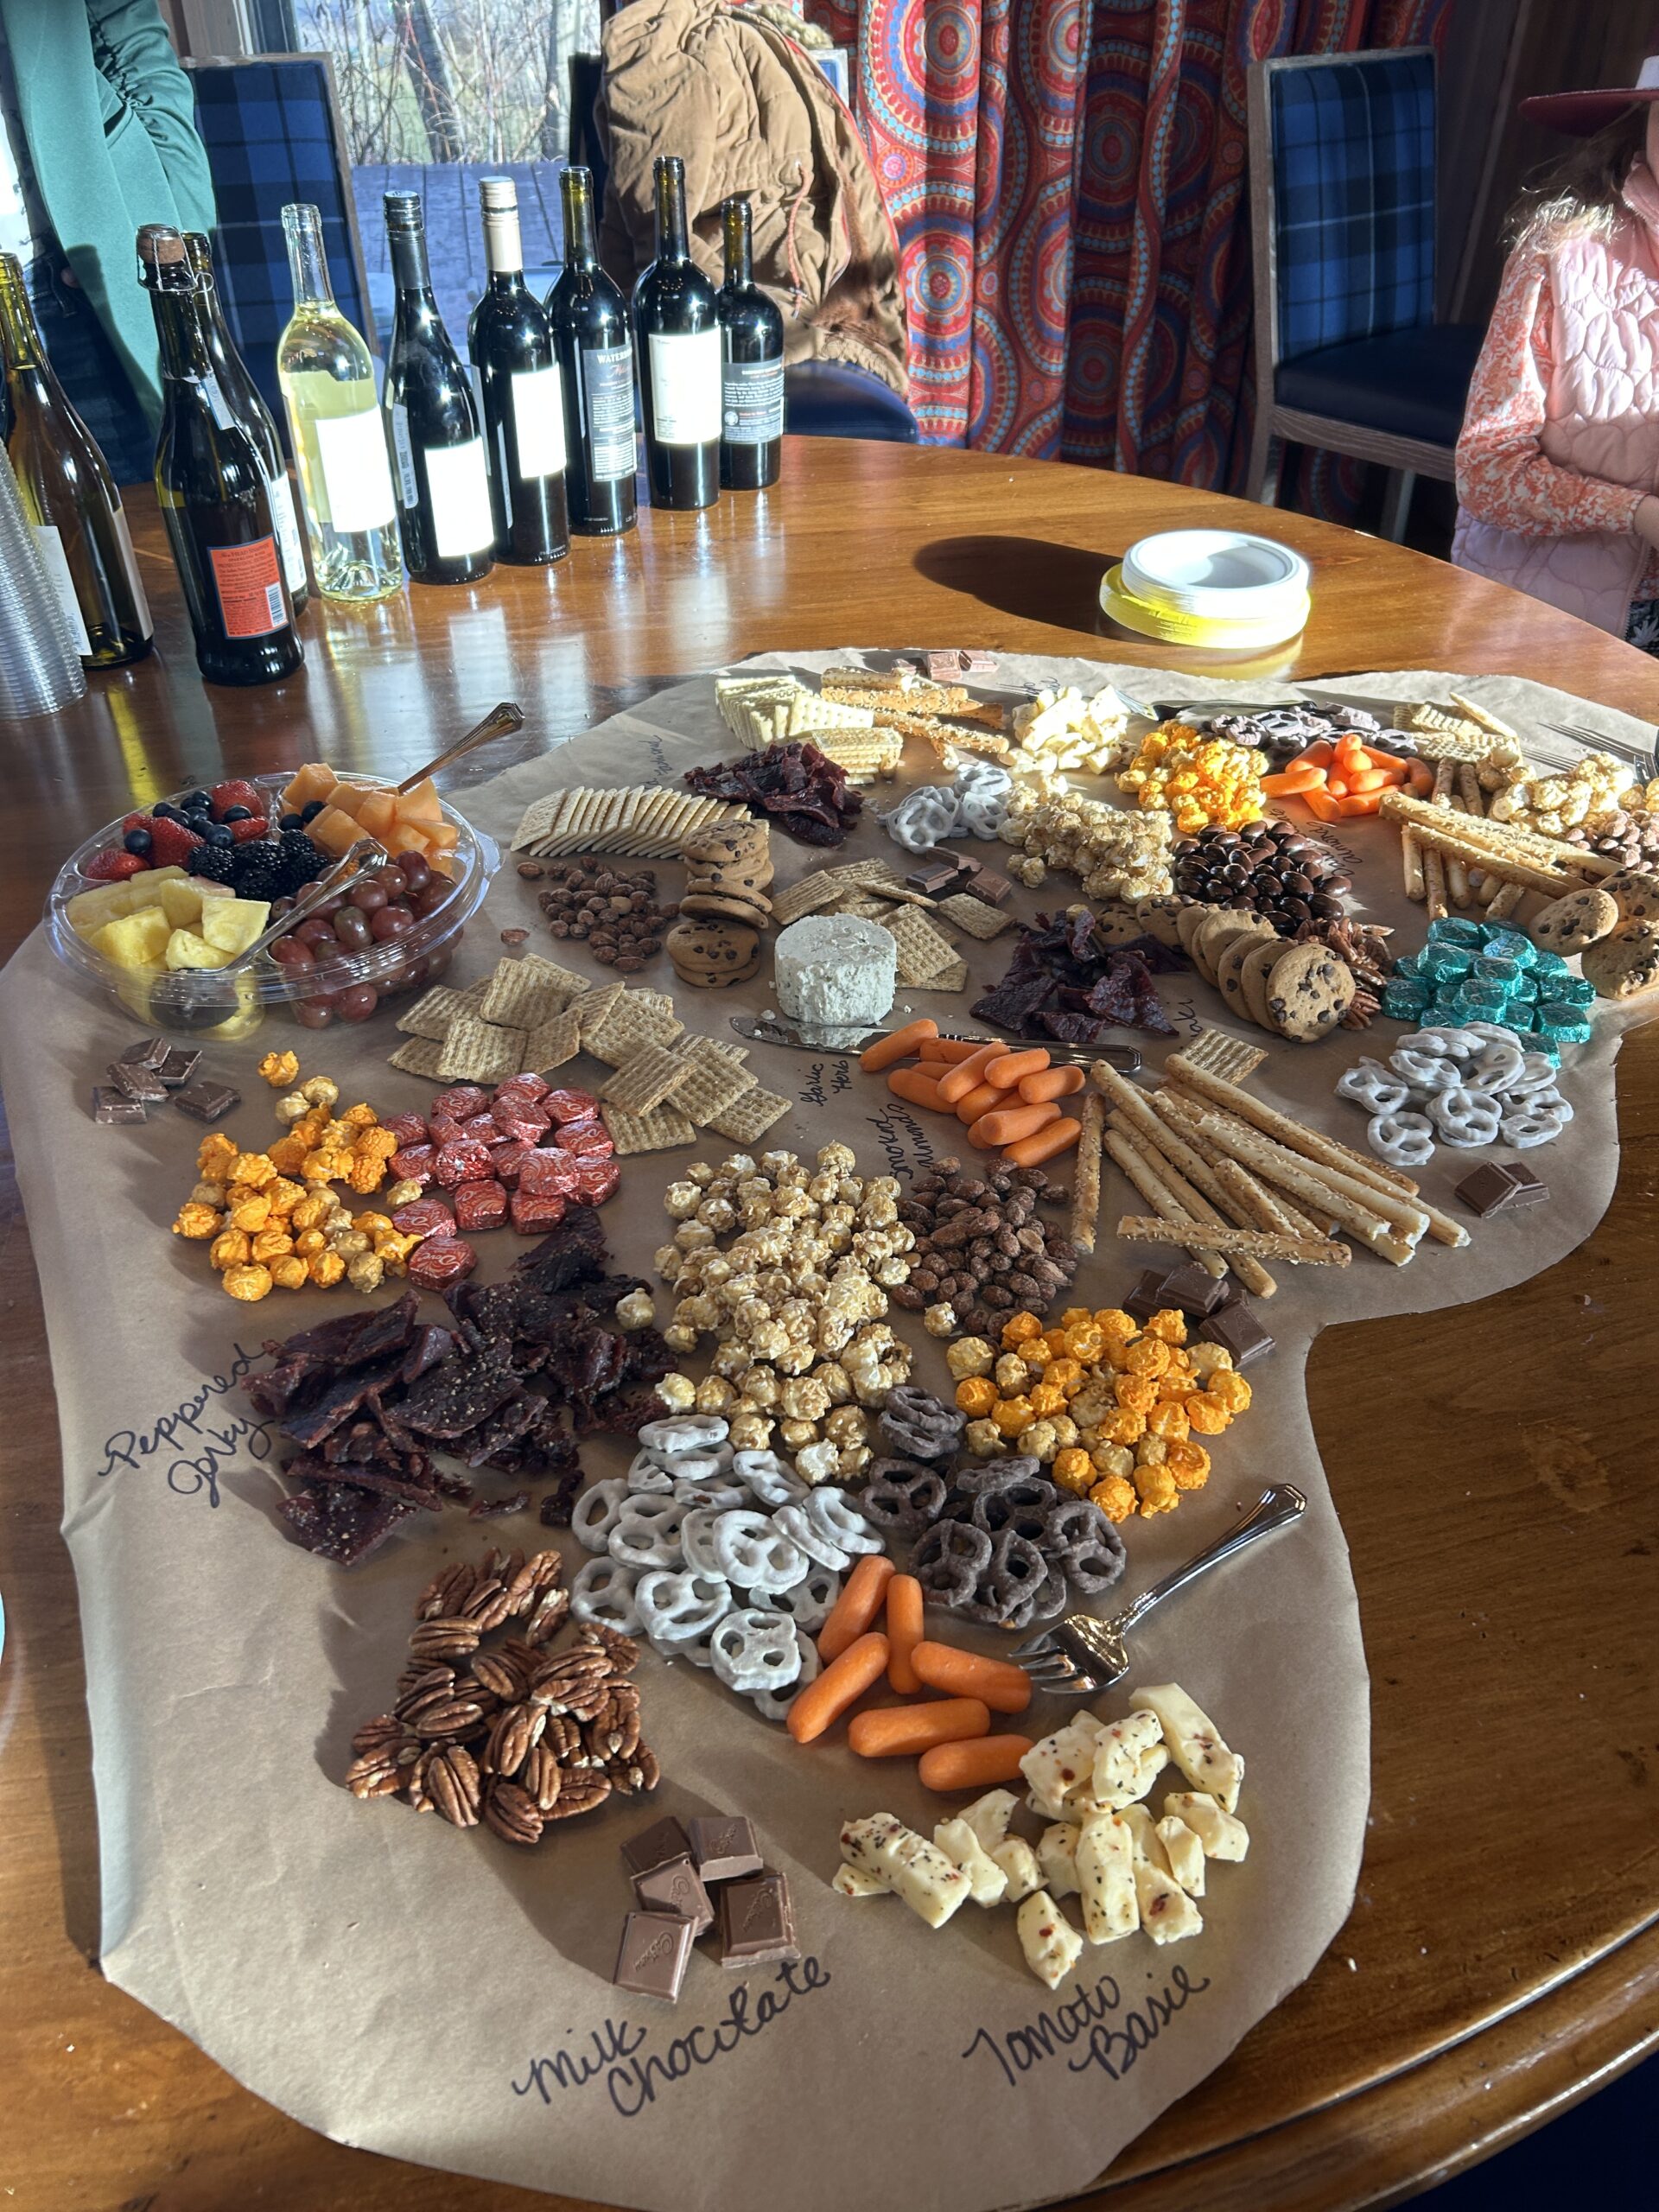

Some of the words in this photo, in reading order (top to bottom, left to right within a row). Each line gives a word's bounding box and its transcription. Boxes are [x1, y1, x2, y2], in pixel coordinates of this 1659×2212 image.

[798, 1063, 828, 1107] Garlic
[830, 1059, 853, 1094] Herb
[421, 1252, 461, 1267] Dove
[98, 1343, 267, 1477] Peppered
[168, 1418, 275, 1509] Jerky
[512, 2018, 647, 2105] Milk
[607, 1956, 831, 2117] Chocolate
[962, 1975, 1121, 2087] Tomato
[1068, 1964, 1211, 2081] Basil
